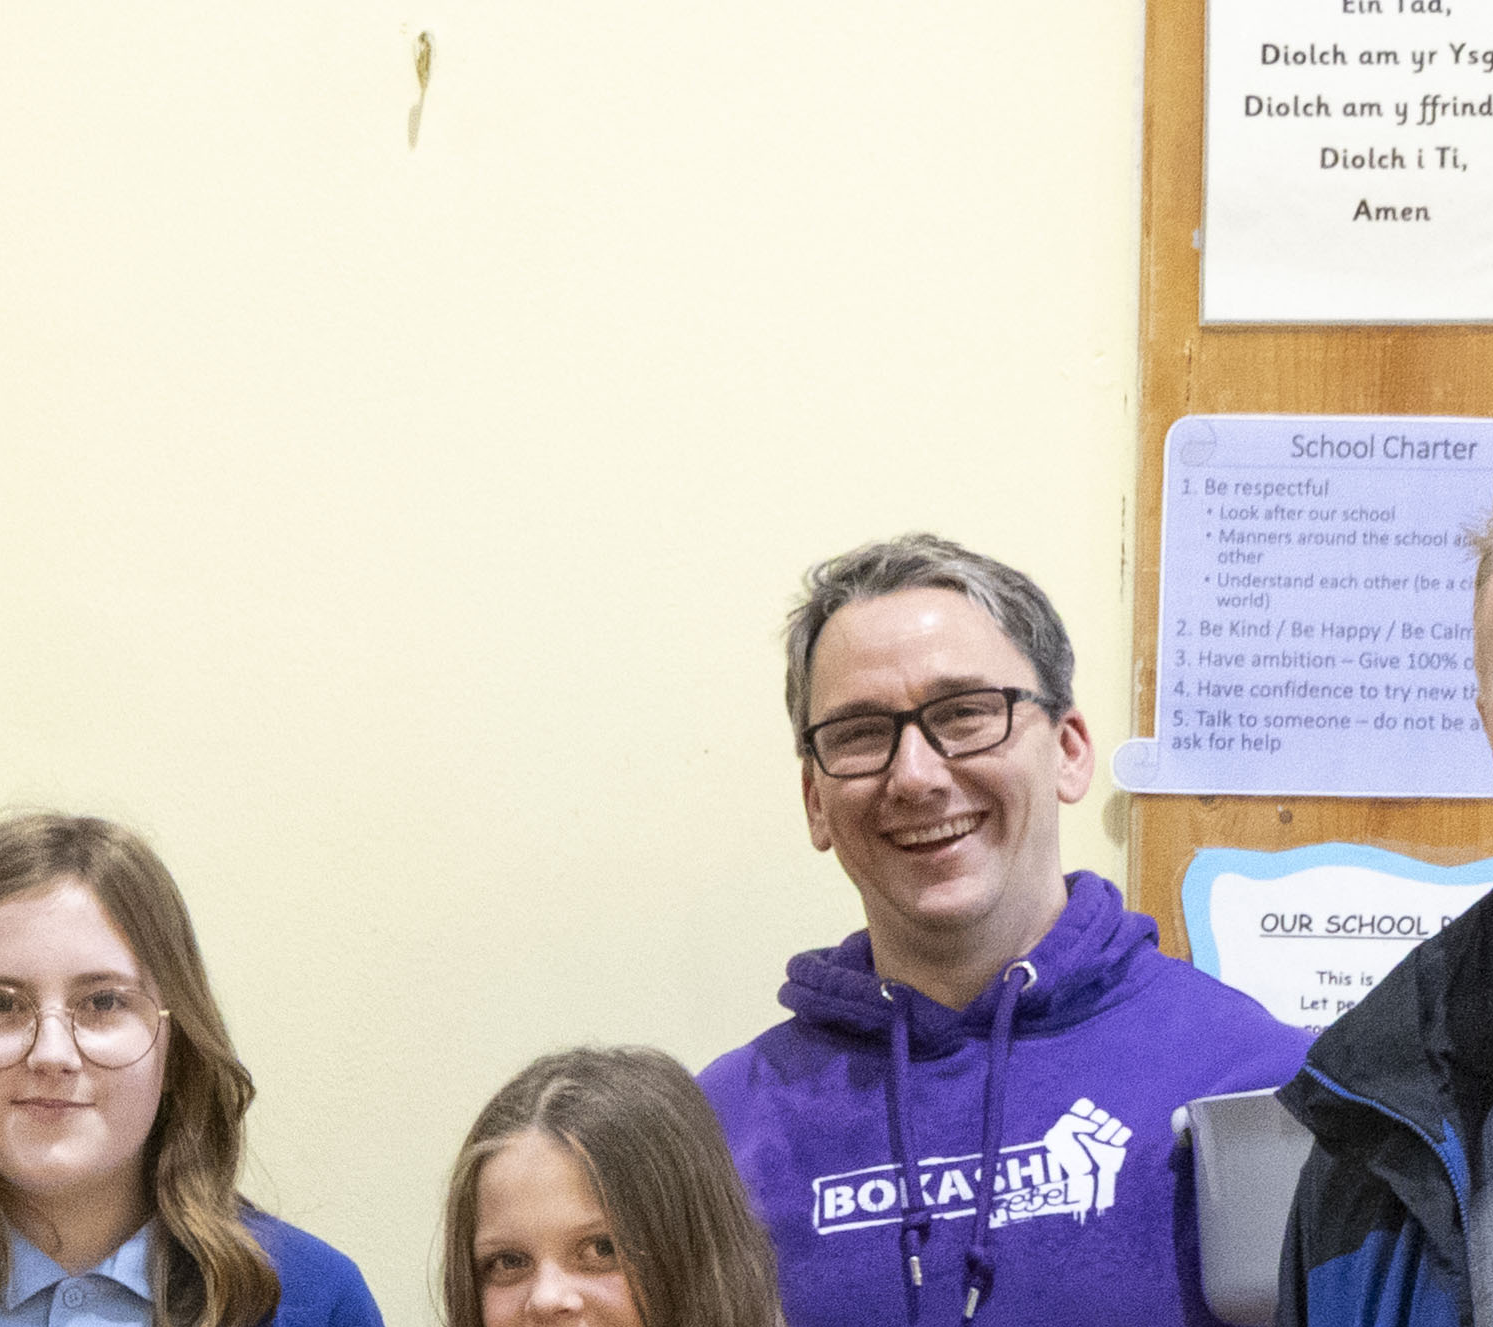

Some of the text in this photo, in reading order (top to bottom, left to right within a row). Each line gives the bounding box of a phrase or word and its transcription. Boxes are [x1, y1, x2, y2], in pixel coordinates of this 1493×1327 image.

[1261, 43, 1346, 66] Diolch
[1359, 49, 1399, 66] am
[1413, 48, 1437, 73] yr
[1245, 95, 1330, 118] Diolch
[1343, 100, 1383, 118] am
[1395, 100, 1408, 125] y
[1320, 147, 1468, 172] Diolch i Ti,
[1353, 200, 1430, 222] Amen
[1291, 435, 1477, 460] School Charter
[1205, 480, 1227, 495] Be
[1234, 480, 1329, 499] respectful
[1220, 507, 1395, 521] Look after our school
[1219, 530, 1292, 544] Manners
[1298, 532, 1356, 545] around
[1362, 533, 1389, 545] the
[1394, 533, 1447, 546] school
[1218, 549, 1264, 564] other
[1217, 575, 1314, 589] Understand
[1320, 575, 1356, 589] each
[1364, 576, 1407, 589] other
[1415, 576, 1440, 591] (be
[1446, 581, 1454, 589] a
[1217, 594, 1270, 609] world)
[1176, 622, 1192, 637] 2.
[1200, 623, 1221, 637] Be
[1229, 622, 1270, 637] Kind
[1291, 623, 1314, 638] Be
[1321, 623, 1381, 642] Happy
[1402, 624, 1424, 639] Be
[1175, 652, 1191, 666] 3.
[1198, 652, 1244, 667] Have
[1251, 652, 1336, 668] ambition
[1359, 653, 1399, 669] Give
[1408, 654, 1457, 669] 100%
[1174, 682, 1190, 697] 4.
[1197, 682, 1243, 697] Have
[1250, 682, 1353, 699] confidence
[1360, 684, 1378, 699] to
[1384, 684, 1411, 702] try
[1417, 688, 1456, 701] new
[1173, 712, 1189, 726] 5.
[1196, 711, 1232, 727] Talk
[1239, 713, 1257, 727] to
[1264, 716, 1351, 729] someone
[1373, 713, 1397, 730] do
[1403, 716, 1434, 730] not
[1441, 716, 1464, 731] be
[1172, 734, 1281, 754] ask for help
[1261, 913, 1313, 933] OUR
[1326, 915, 1429, 935] SCHOOL
[1316, 971, 1373, 986] This is
[1300, 996, 1328, 1010] Let
